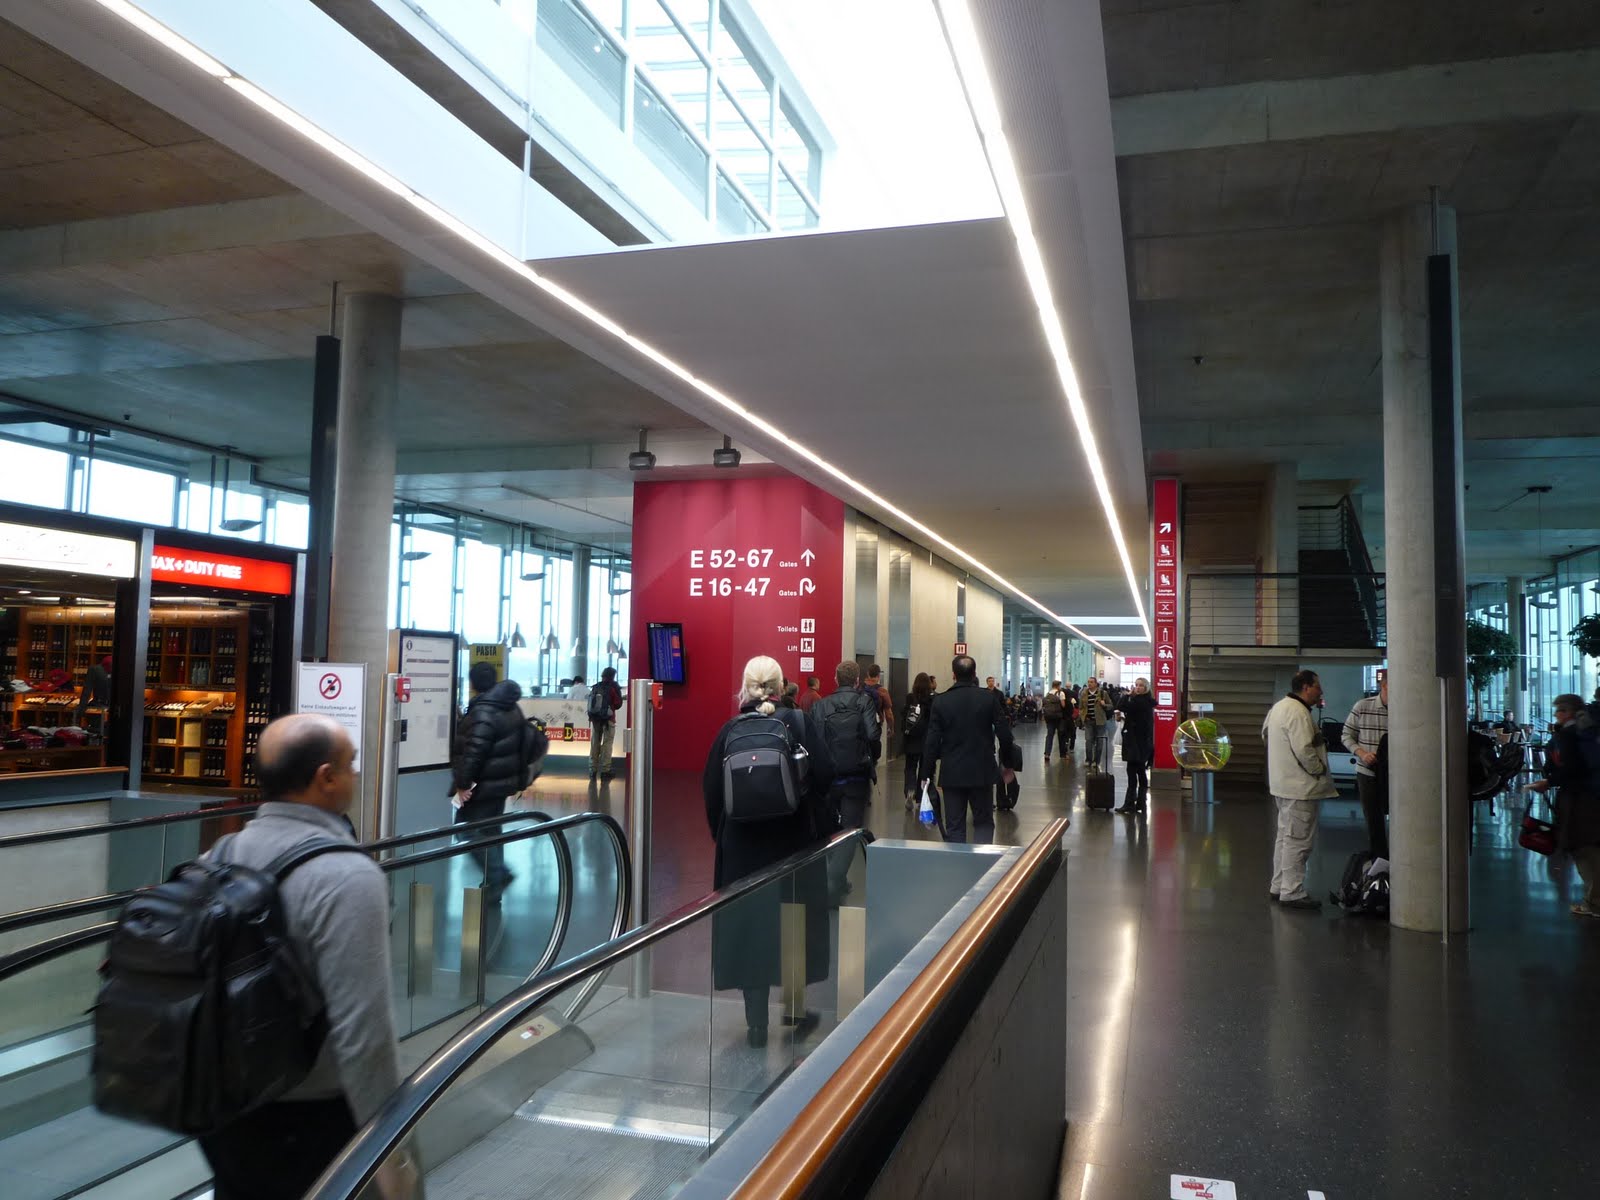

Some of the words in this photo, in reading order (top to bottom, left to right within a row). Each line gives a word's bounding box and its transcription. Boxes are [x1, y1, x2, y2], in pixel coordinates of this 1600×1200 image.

[690, 549, 704, 568] E
[709, 548, 774, 568] 52-67
[216, 563, 242, 579] FREE
[689, 578, 703, 596] E
[708, 577, 771, 596] 16-47
[476, 645, 497, 657] PASTA
[564, 726, 589, 740] Deli
